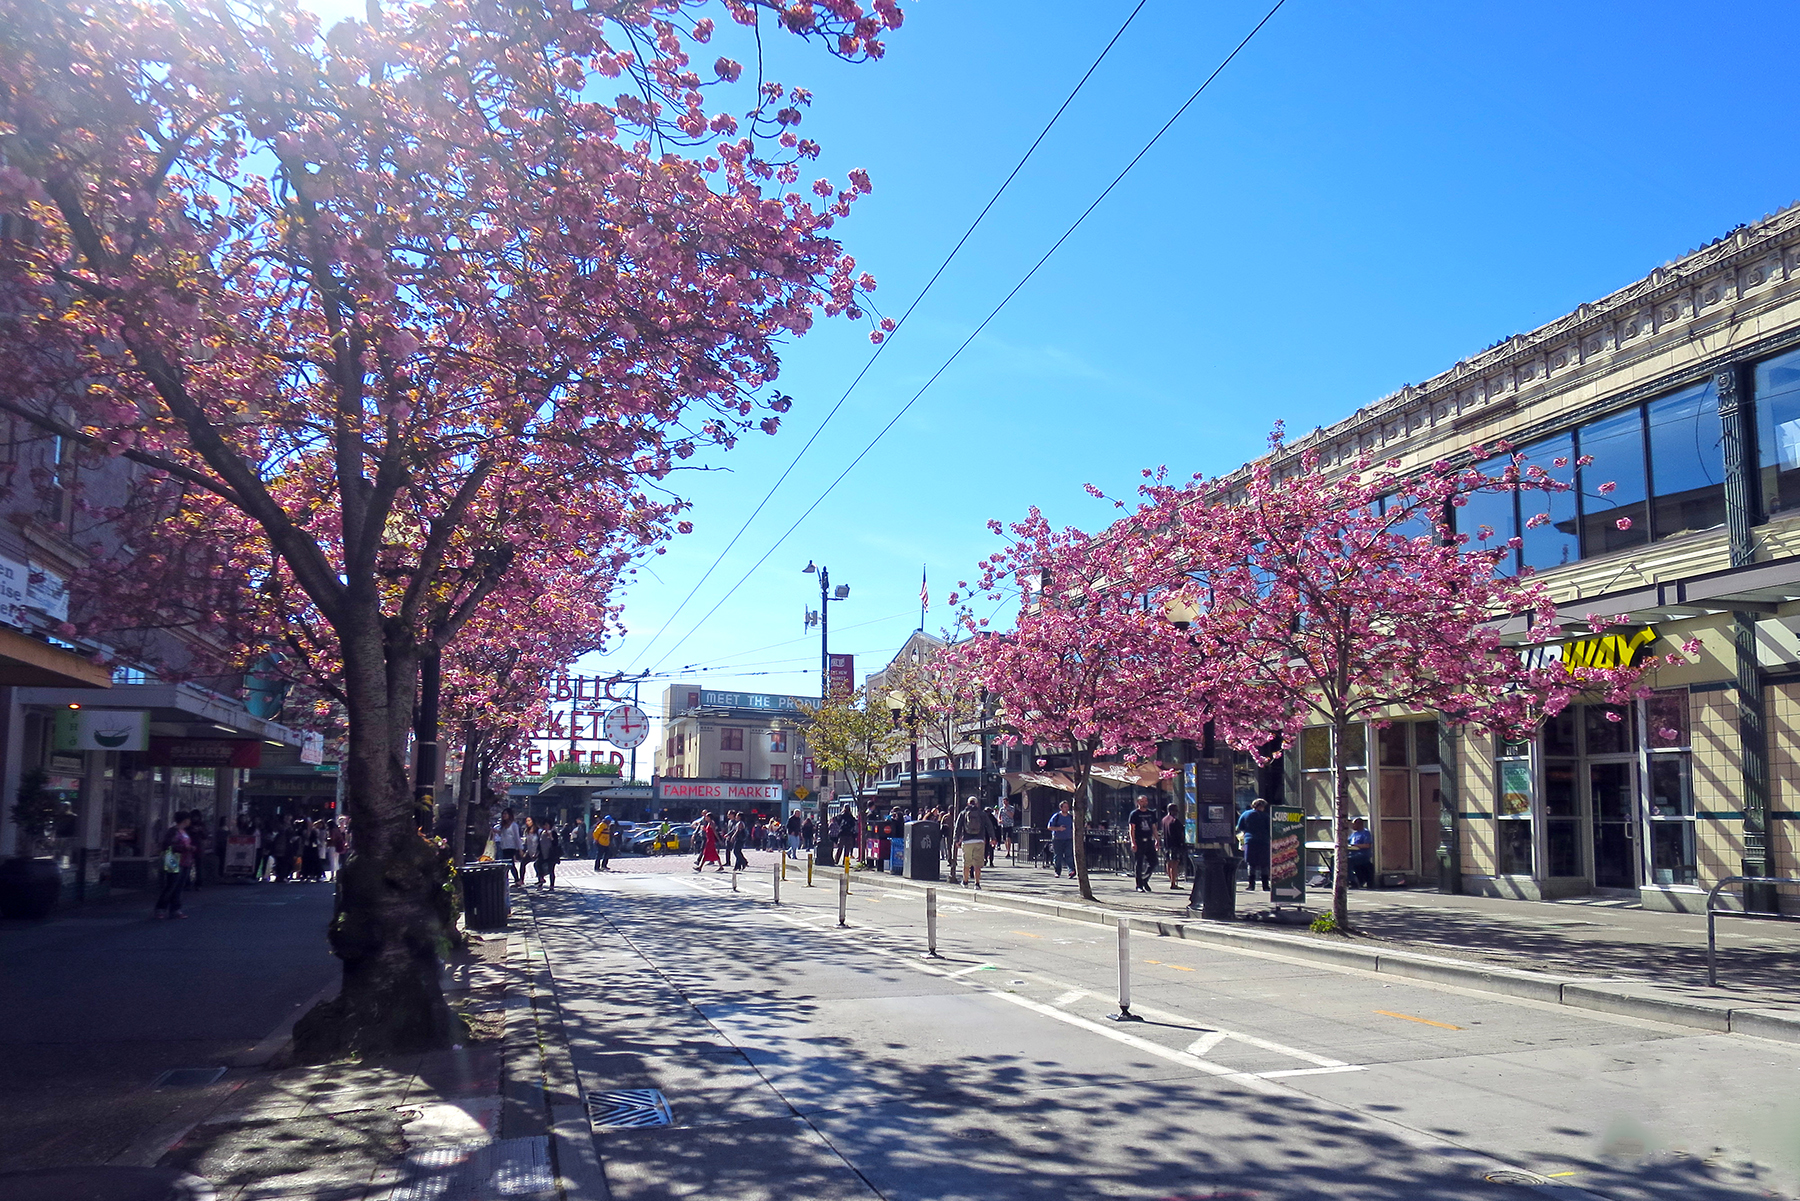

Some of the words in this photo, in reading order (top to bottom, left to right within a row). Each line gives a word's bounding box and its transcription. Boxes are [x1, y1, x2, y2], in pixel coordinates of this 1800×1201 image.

[1501, 626, 1657, 692] UBWAY
[545, 674, 622, 702] BLIC
[706, 692, 740, 705] MEET
[747, 695, 771, 708] THE
[526, 749, 625, 778] ENTER
[663, 784, 722, 797] FARMERS
[728, 786, 779, 798] MARKET
[1272, 811, 1305, 823] SUBWAY
